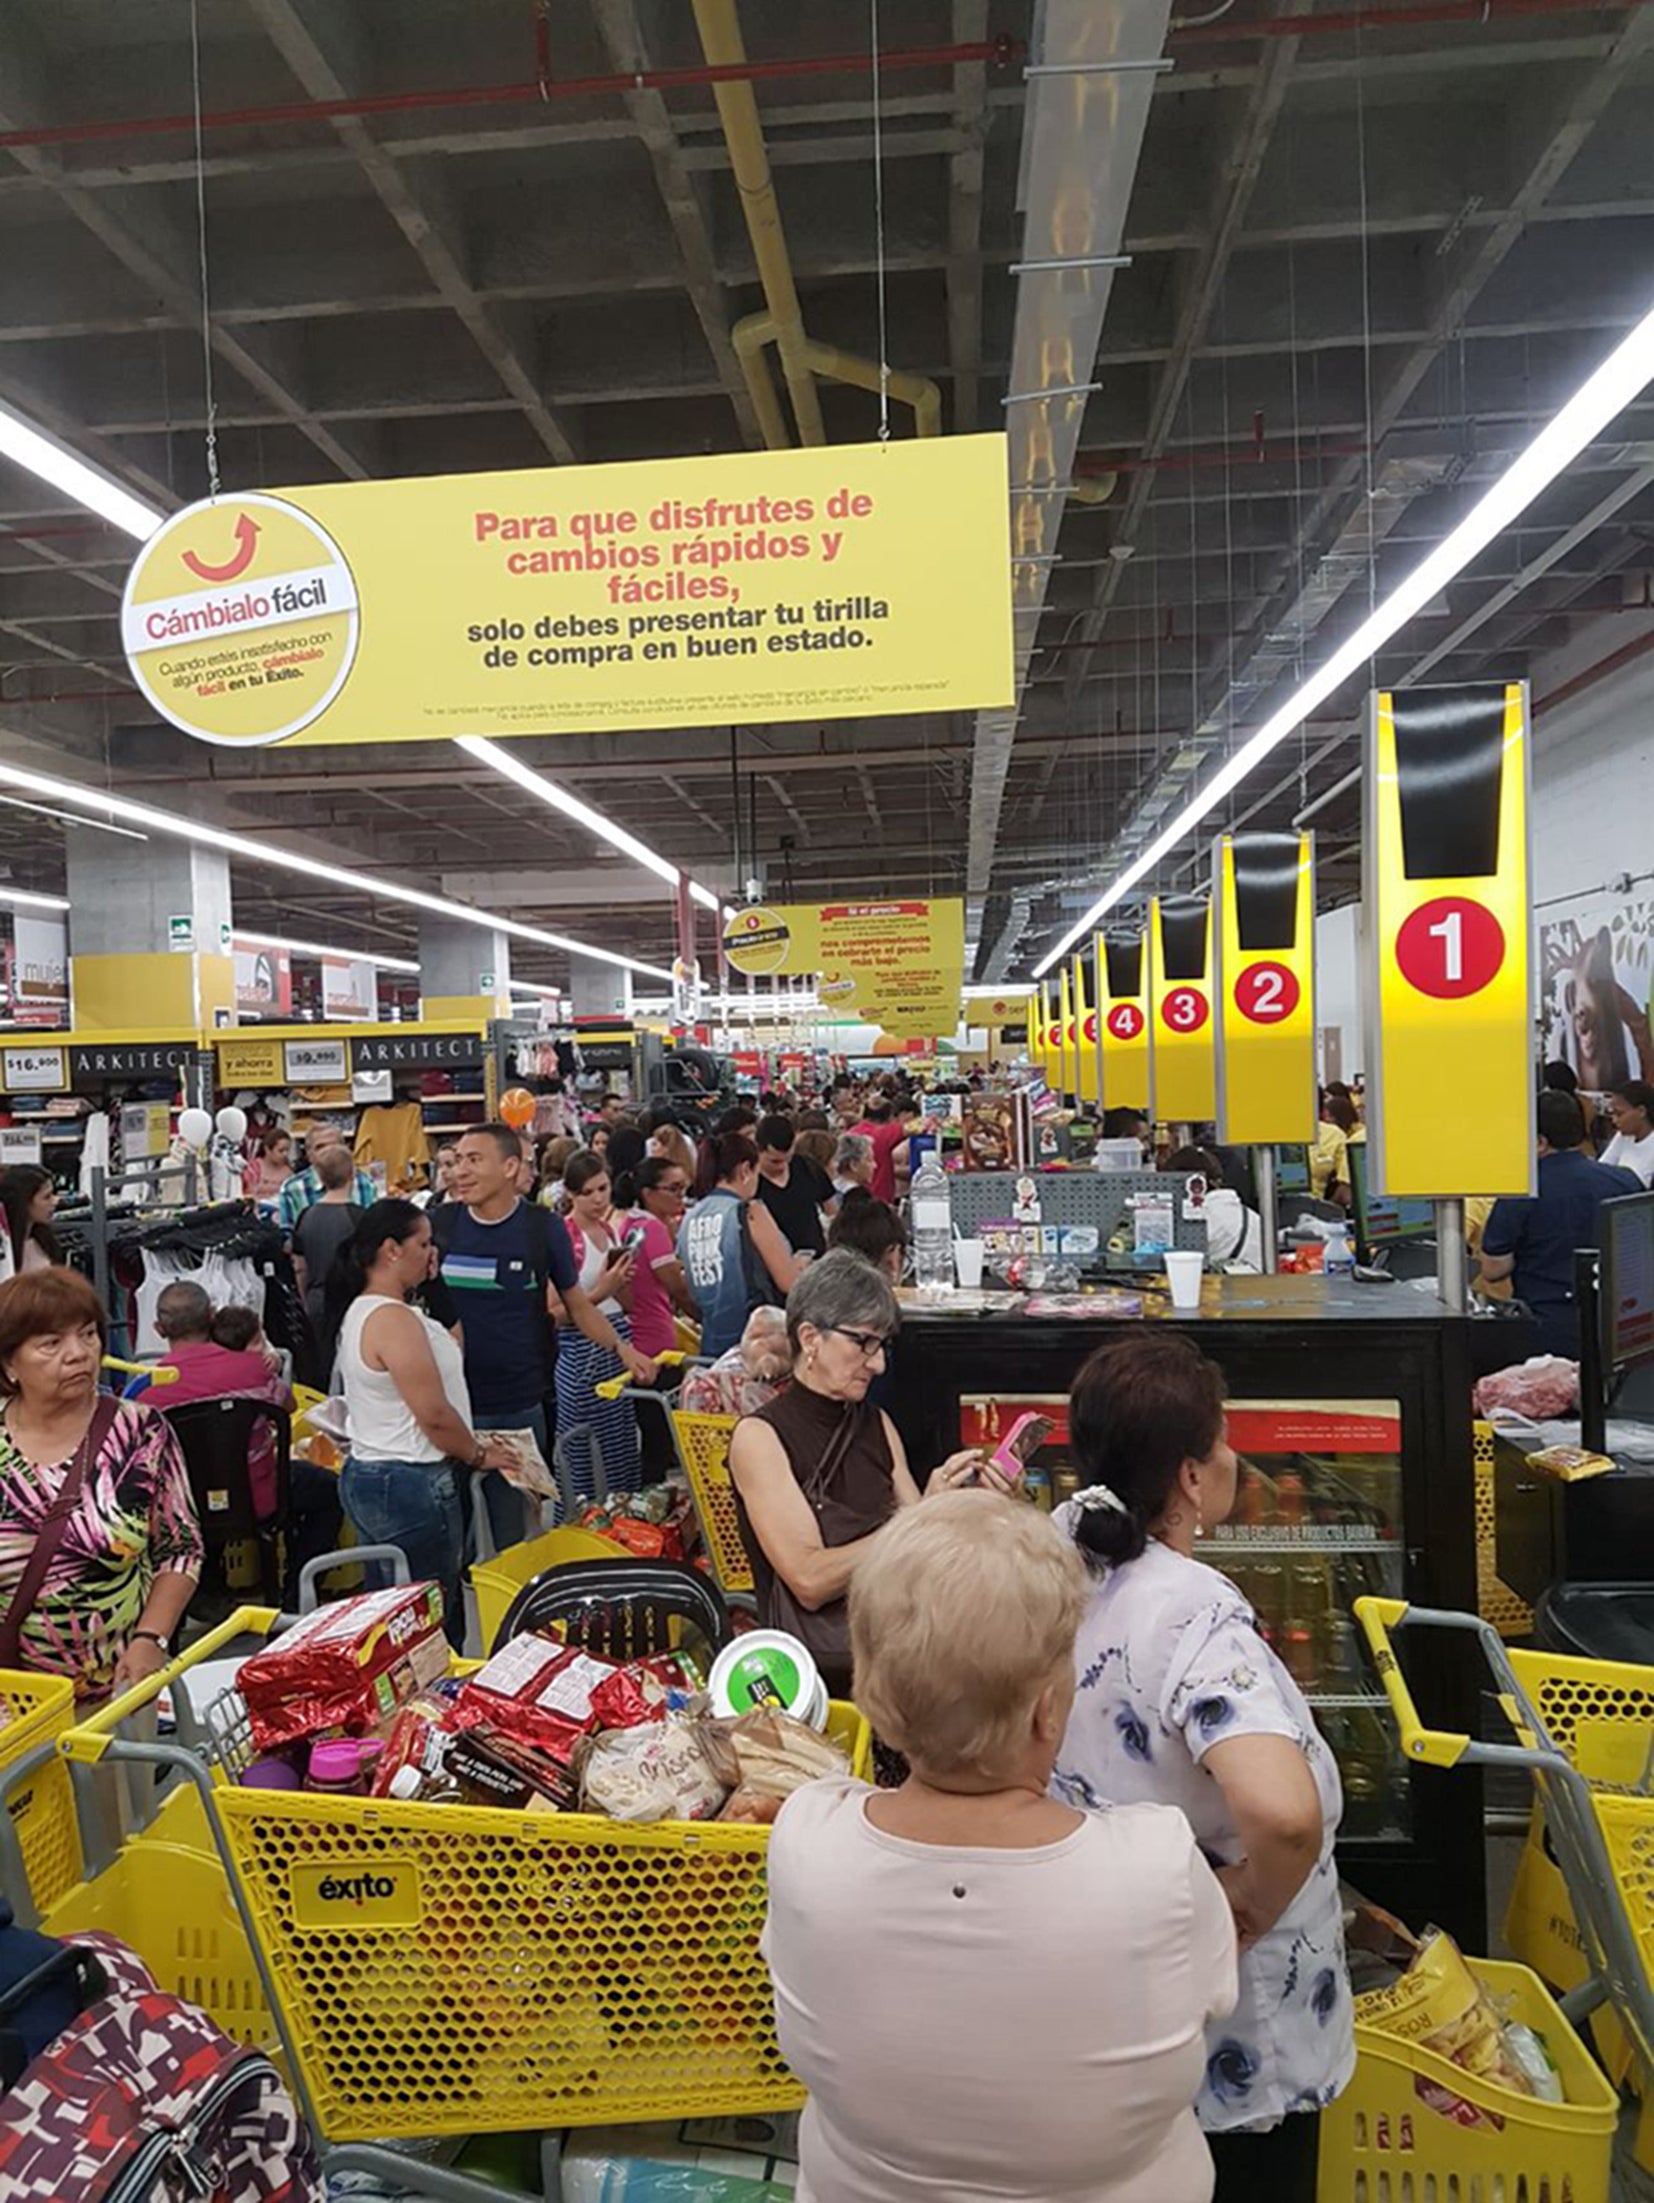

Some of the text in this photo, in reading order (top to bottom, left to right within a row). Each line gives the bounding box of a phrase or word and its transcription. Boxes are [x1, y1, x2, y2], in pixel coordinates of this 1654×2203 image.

[475, 488, 873, 546] Para que disfrutes de
[507, 531, 843, 575] cambios rápidos y
[607, 573, 740, 604] fáciles,
[147, 579, 326, 639] Cámbialo fácil
[467, 597, 889, 642] solo debes presentar tu tirilla
[159, 657, 206, 677] Cuando
[240, 636, 308, 661] insatisfecho
[308, 632, 332, 646] con
[483, 626, 873, 669] de compra en buen estado.
[228, 679, 246, 691] en
[249, 674, 264, 687] tu
[1429, 912, 1462, 980] 1
[1252, 970, 1284, 1013] 2
[1115, 1008, 1134, 1033] 4
[1173, 994, 1196, 1025] 3
[77, 1050, 191, 1071] ARKITECT
[235, 1056, 273, 1068] ahorra
[359, 1039, 475, 1061] ARKITECT
[690, 1261, 723, 1287] FEST
[318, 1872, 395, 1906] éxito
